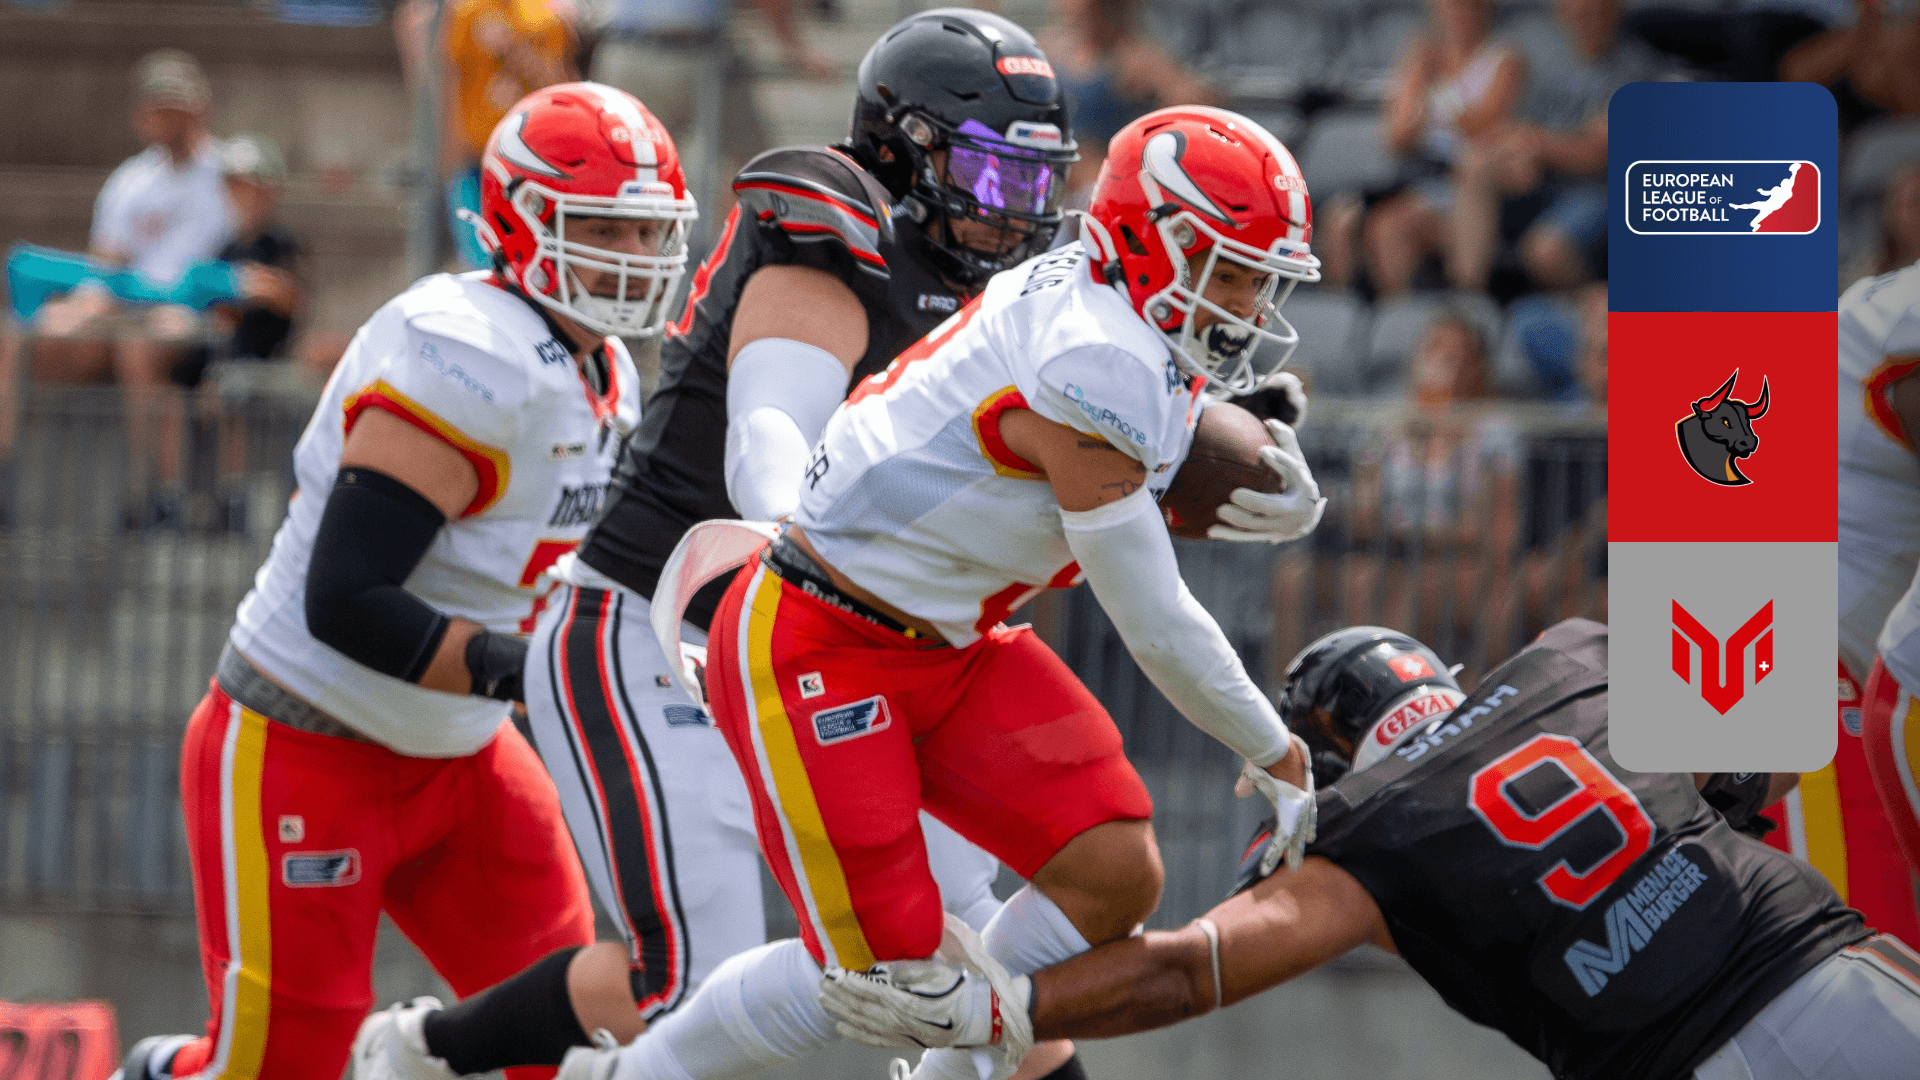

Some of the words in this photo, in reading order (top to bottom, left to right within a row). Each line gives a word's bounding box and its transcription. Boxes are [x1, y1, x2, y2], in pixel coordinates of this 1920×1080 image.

[1381, 695, 1456, 738] GAZI
[1468, 732, 1656, 911] 9
[1626, 850, 1690, 913] MENACE
[1641, 862, 1708, 933] BURGER
